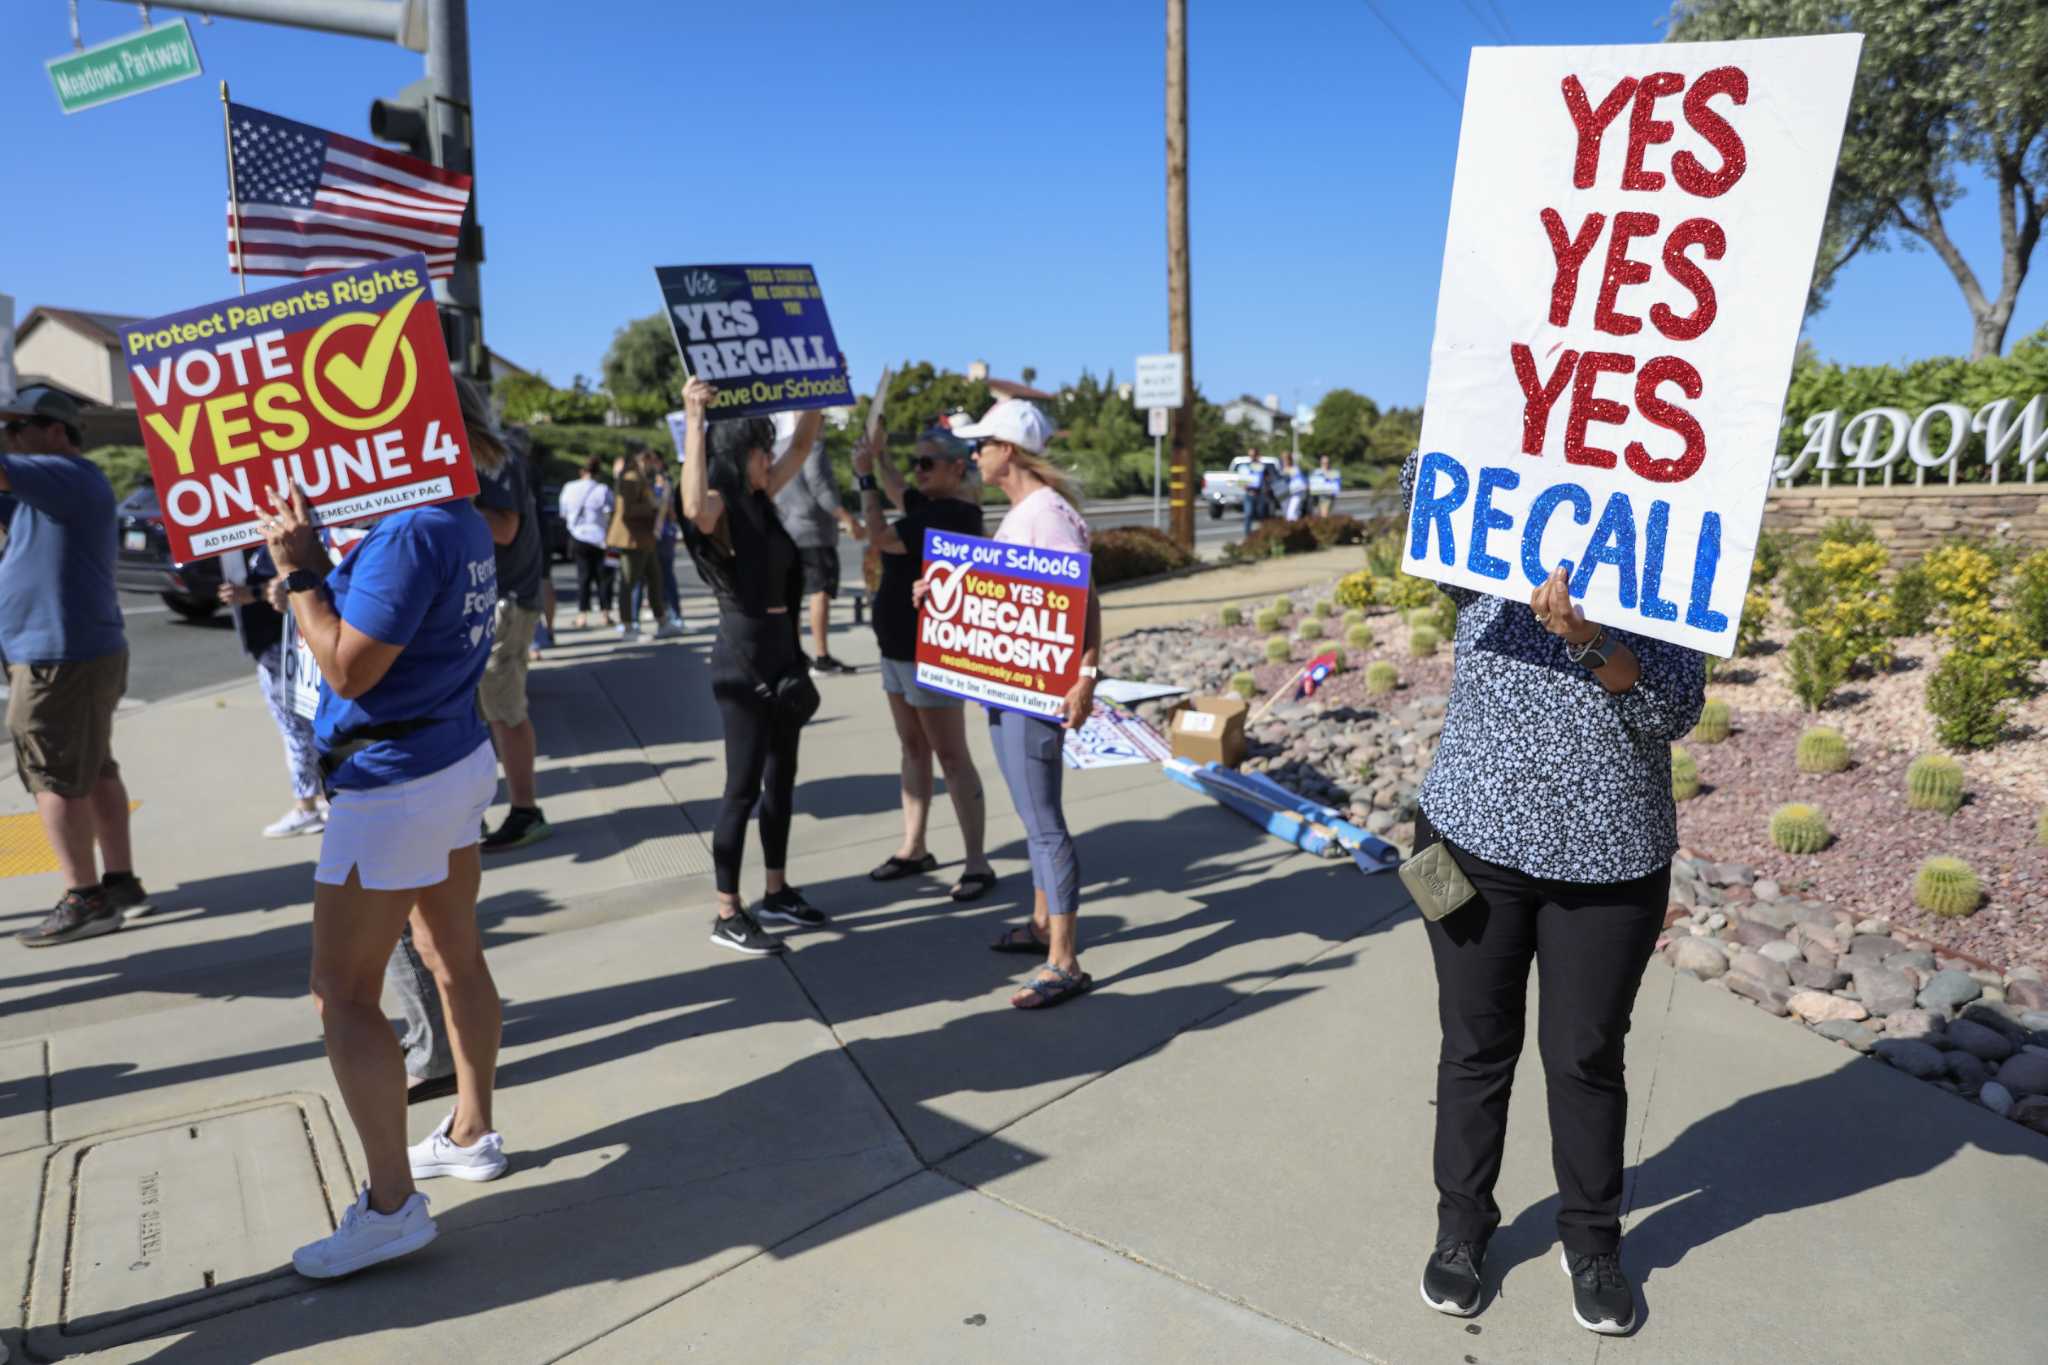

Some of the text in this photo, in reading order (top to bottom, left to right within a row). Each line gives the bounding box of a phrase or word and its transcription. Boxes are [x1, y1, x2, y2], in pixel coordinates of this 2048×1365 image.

[57, 40, 191, 98] Meadows Parkway
[1561, 65, 1748, 198] YES
[1540, 207, 1726, 341] YES
[128, 269, 419, 355] Protect Parents Rights
[673, 300, 759, 341] YES
[133, 329, 293, 407] VOTE
[686, 336, 836, 381] RECALL
[751, 381, 784, 402] Our
[1510, 342, 1706, 483] YES
[145, 382, 310, 475] YES
[1772, 393, 2048, 479] ADOW
[166, 420, 460, 527] ON JUNE 4
[315, 484, 442, 520] TEMECULA VALLEY PAC
[204, 536, 220, 548] AD
[221, 530, 247, 543] PAID
[931, 535, 1081, 579] Save our Schools
[1410, 452, 1729, 633] RECALL
[962, 594, 1075, 645] RECALL
[965, 574, 1070, 611] Vote YES to
[922, 616, 1073, 675] KOMROSKY
